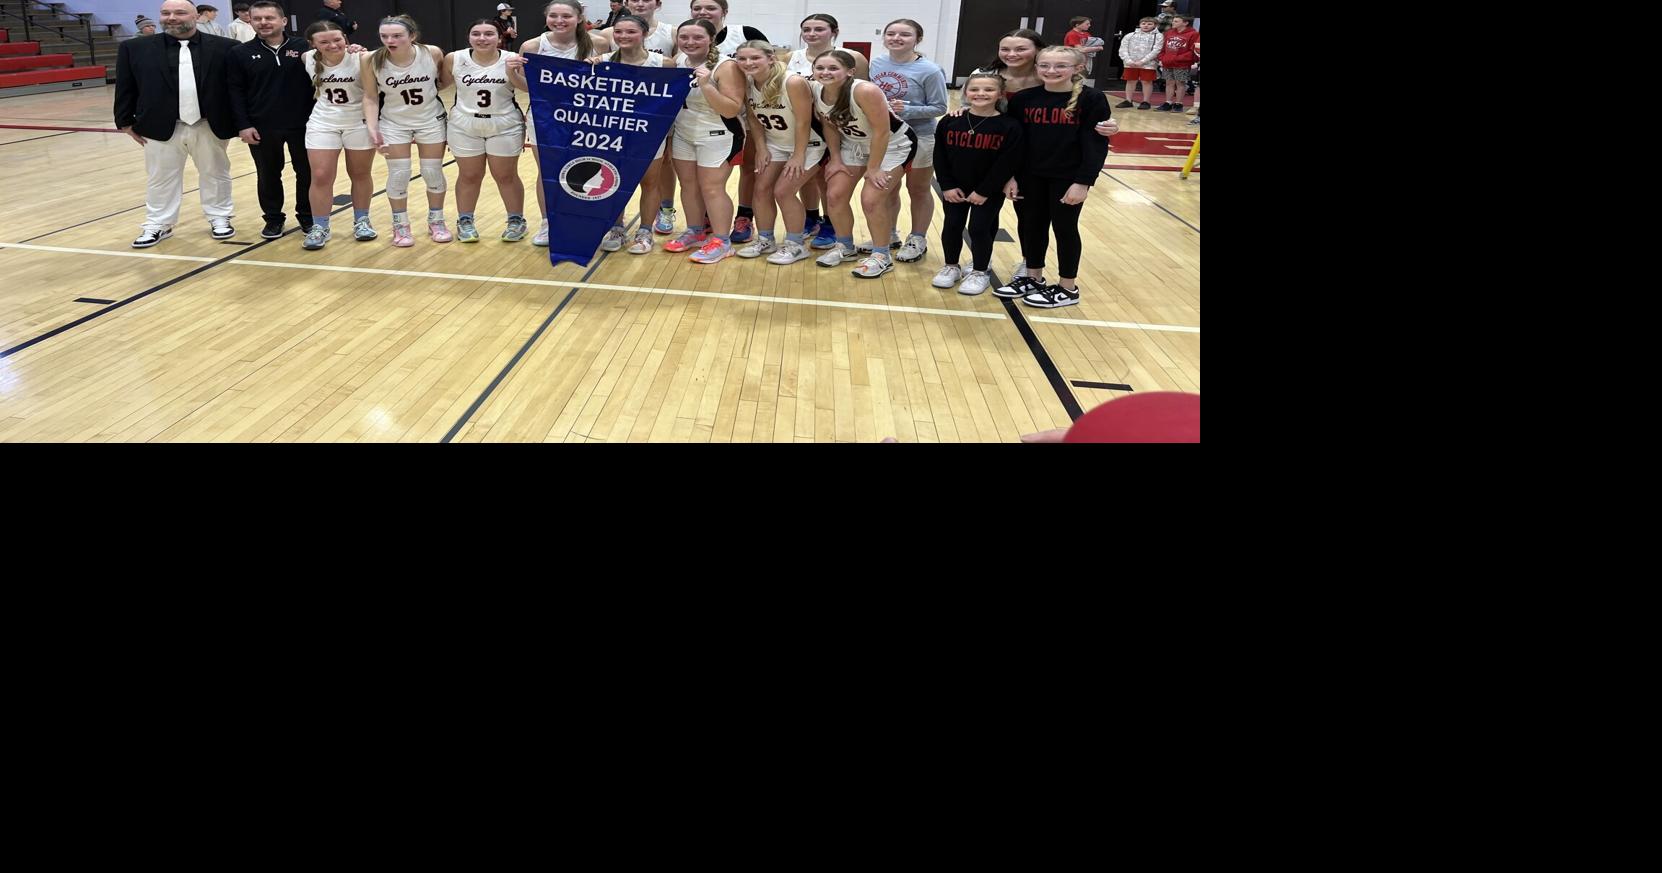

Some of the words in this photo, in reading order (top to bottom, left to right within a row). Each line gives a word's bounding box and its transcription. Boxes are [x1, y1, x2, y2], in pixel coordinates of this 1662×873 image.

[385, 74, 431, 89] Cyclones
[461, 74, 507, 87] Cyclones
[539, 69, 674, 98] BASKETBALL
[324, 87, 349, 104] 13
[400, 88, 424, 106] 15
[476, 89, 492, 108] 3
[573, 92, 636, 113] STATE
[553, 108, 649, 133] QUALIFIER
[756, 113, 788, 131] 33
[571, 130, 624, 152] 2024
